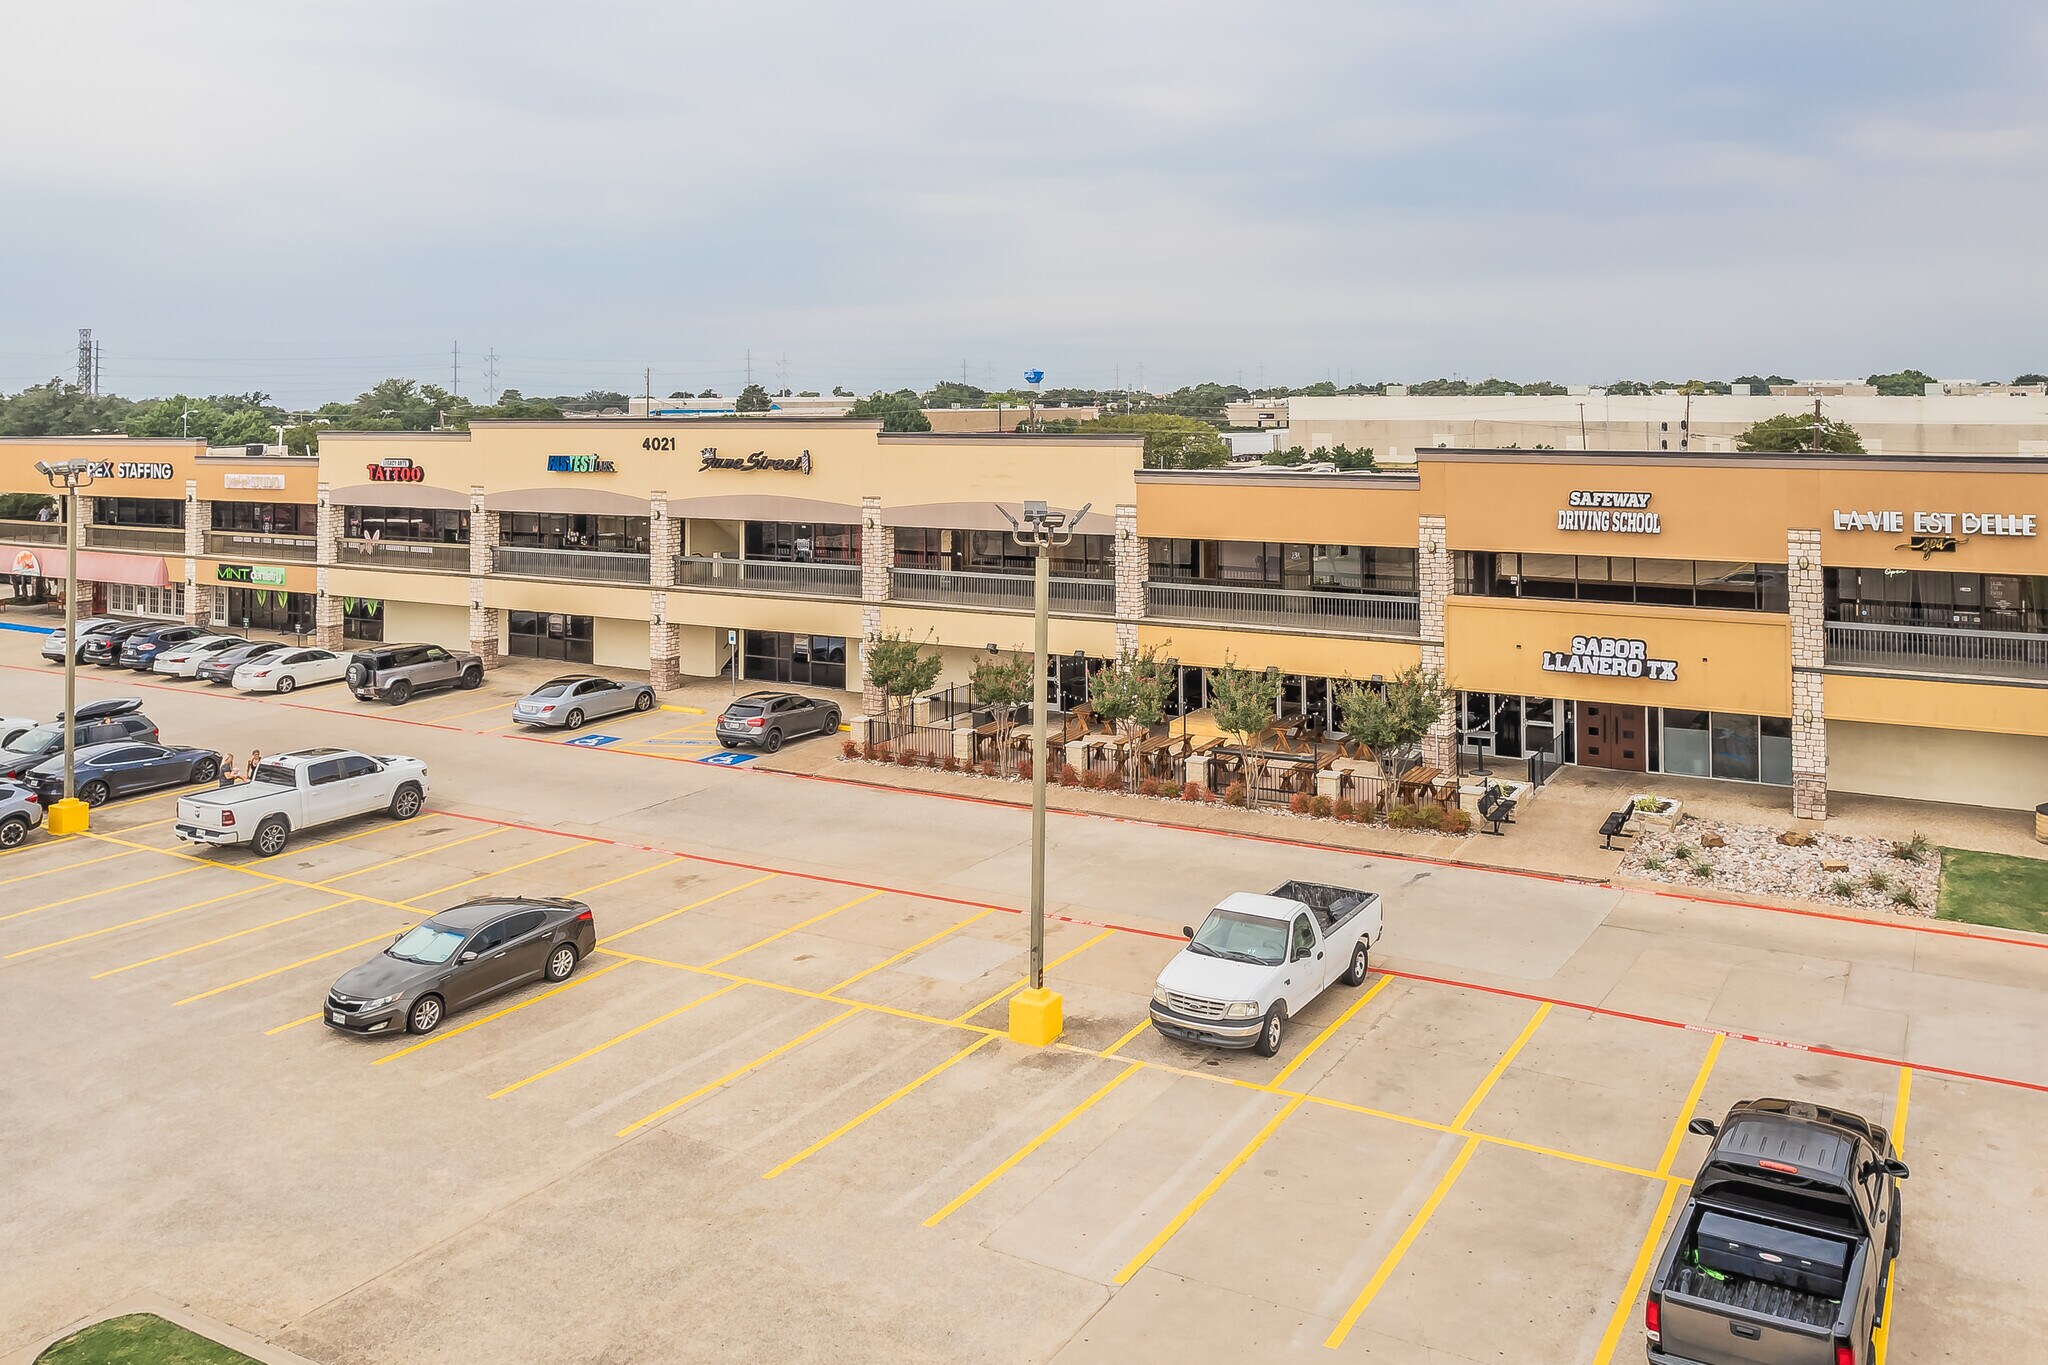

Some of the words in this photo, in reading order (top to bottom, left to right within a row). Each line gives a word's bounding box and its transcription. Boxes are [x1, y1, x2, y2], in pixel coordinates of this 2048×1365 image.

[642, 437, 676, 451] 4021
[118, 462, 173, 479] STAFFING
[740, 450, 804, 472] Street
[367, 464, 422, 481] TATTOO
[1569, 491, 1651, 508] SAFEWAY
[1557, 510, 1610, 531] DRIVING
[1612, 512, 1661, 533] SCHOOL
[1914, 512, 1957, 534] EST
[1962, 513, 2037, 536] BELLE
[1571, 637, 1646, 660] SABOR
[1542, 653, 1643, 678] LLANERO
[1646, 660, 1678, 681] TX
